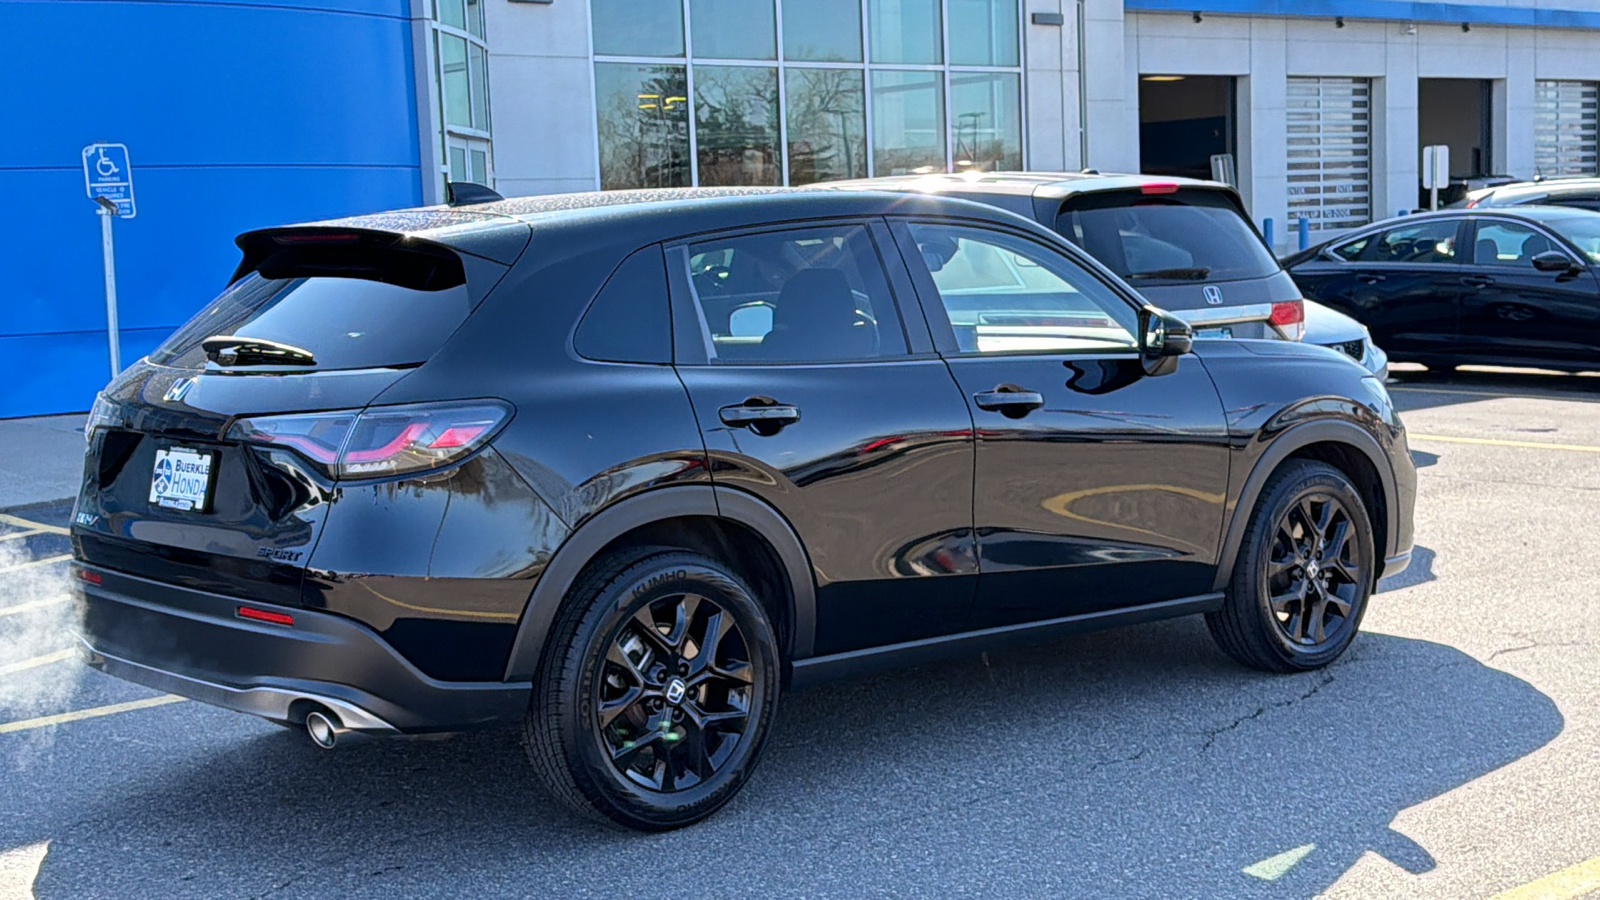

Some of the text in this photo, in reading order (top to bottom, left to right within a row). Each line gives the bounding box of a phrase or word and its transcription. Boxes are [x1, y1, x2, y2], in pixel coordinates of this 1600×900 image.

[175, 459, 210, 475] BUERKLE
[171, 472, 207, 496] HONDA
[257, 547, 304, 562] SPORT
[631, 569, 687, 599] KUMHO
